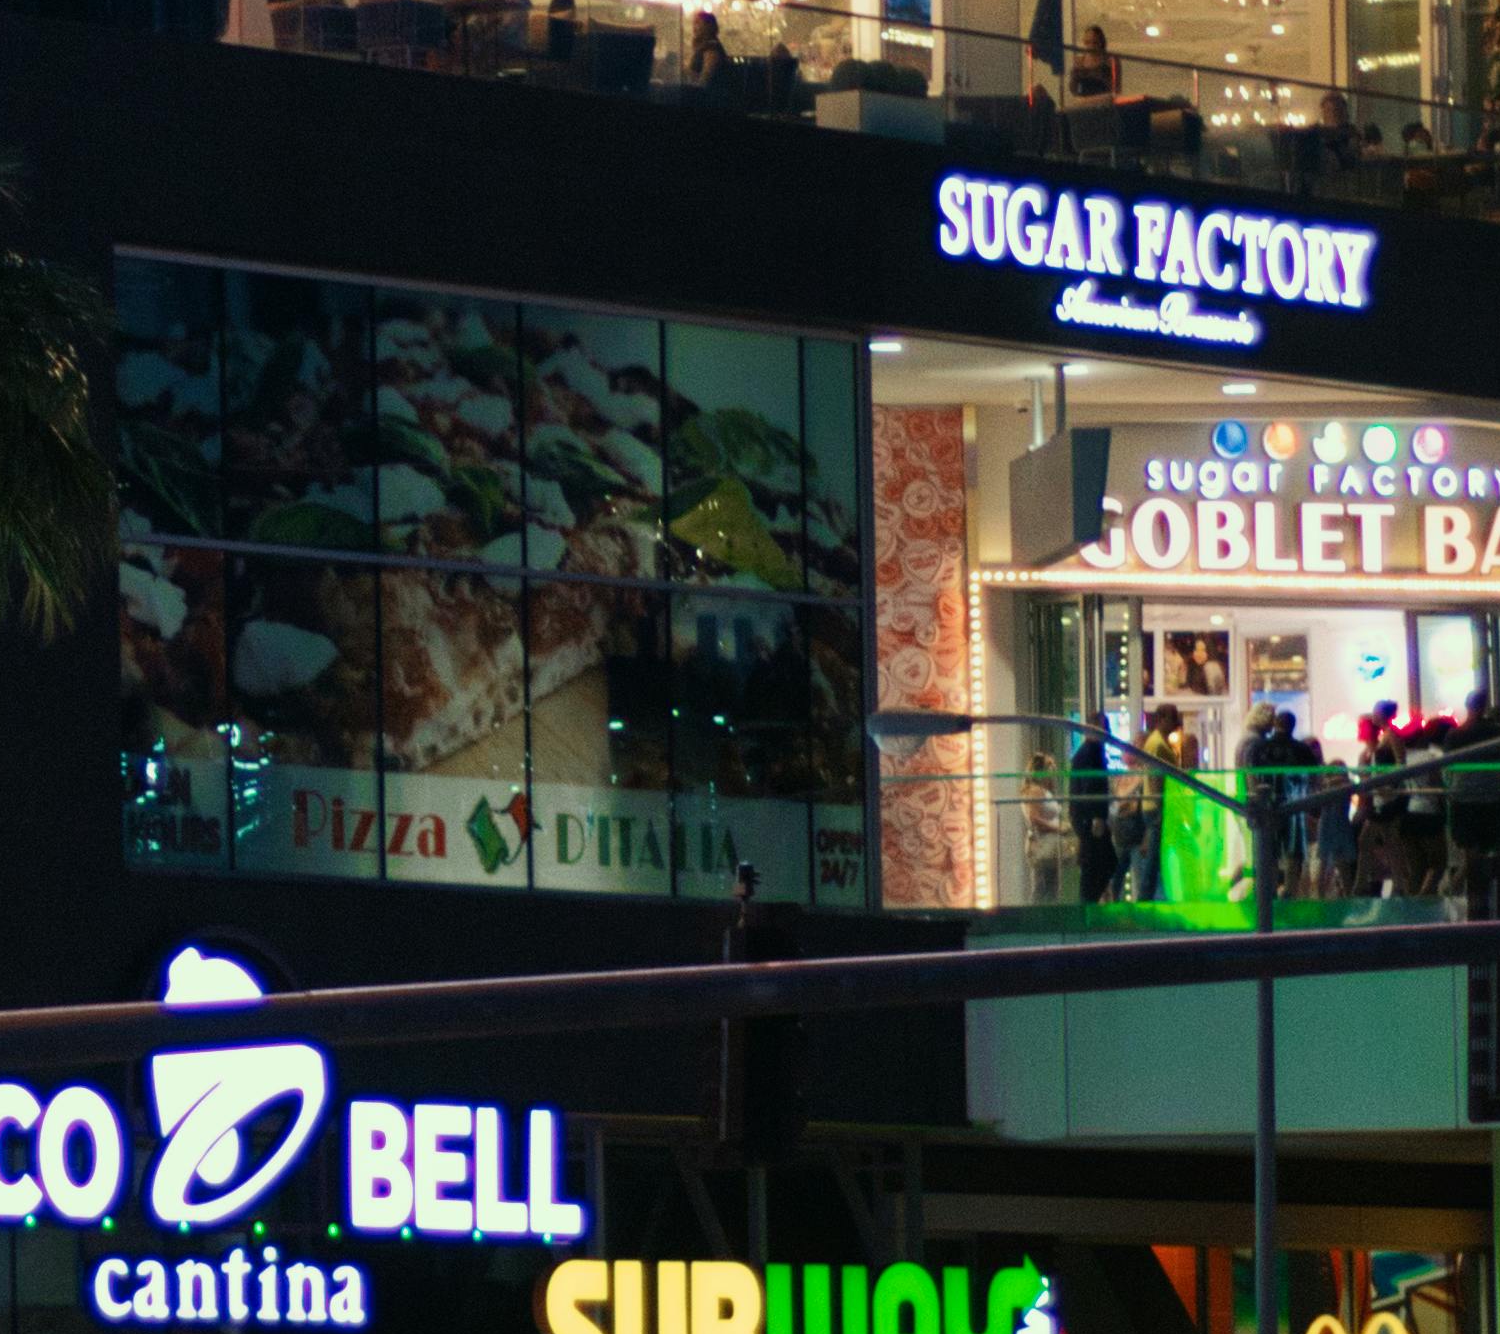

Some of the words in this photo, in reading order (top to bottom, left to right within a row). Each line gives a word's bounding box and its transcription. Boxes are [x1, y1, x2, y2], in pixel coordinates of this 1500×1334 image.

[937, 176, 1124, 276] SUGAR
[1133, 203, 1372, 308] FACTORY
[1078, 495, 1396, 574] GOBLET
[291, 789, 449, 860] Pizza
[349, 1101, 582, 1236] BELL
[94, 1247, 366, 1327] cantina
